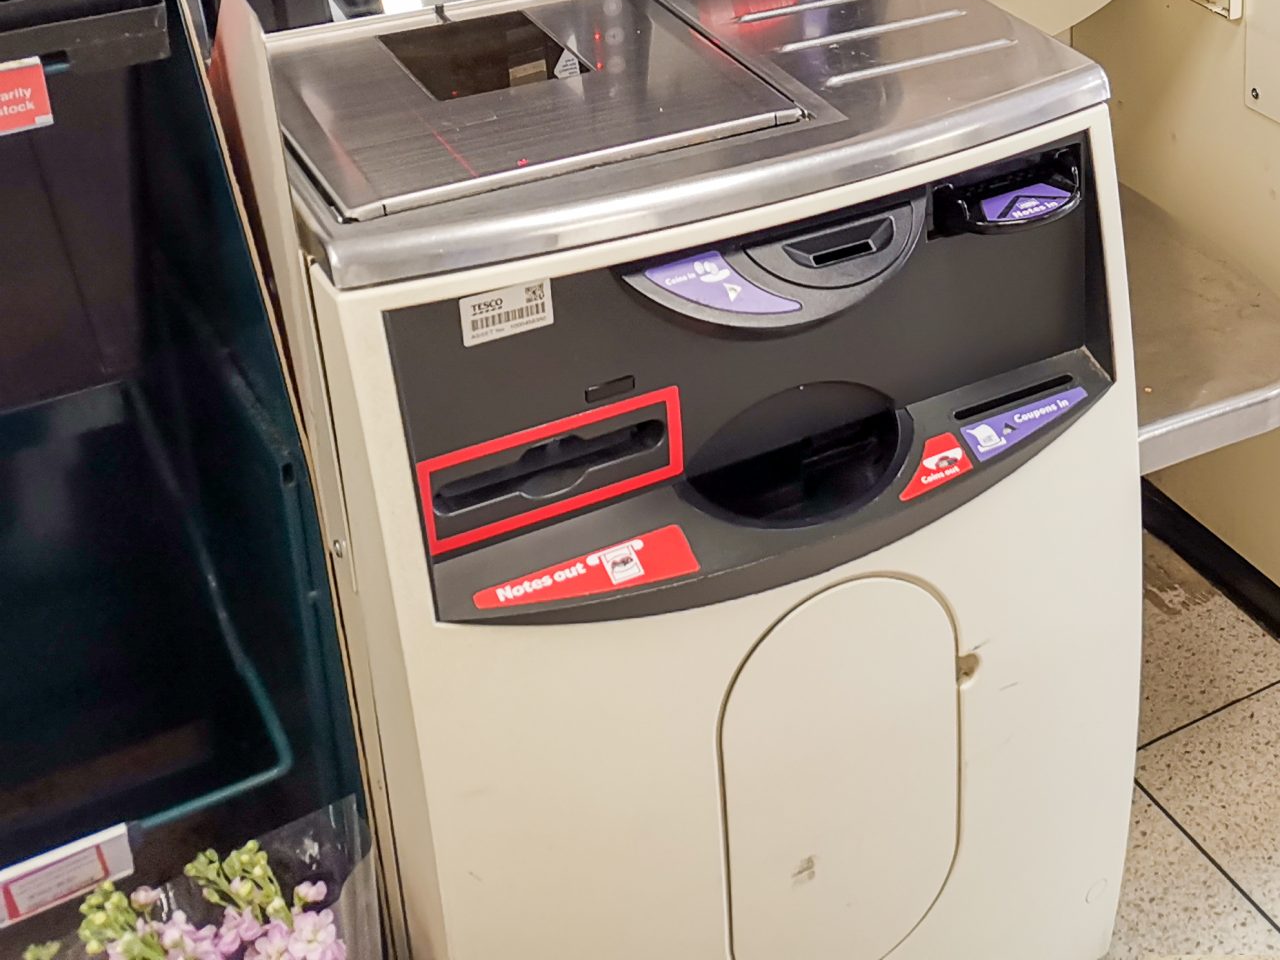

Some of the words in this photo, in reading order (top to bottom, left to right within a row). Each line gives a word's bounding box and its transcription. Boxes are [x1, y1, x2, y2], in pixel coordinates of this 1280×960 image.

[1012, 203, 1046, 218] Notes
[665, 274, 687, 286] Coins
[688, 271, 696, 279] in
[471, 297, 503, 313] TESCO
[1014, 403, 1058, 423] Coupons
[1058, 398, 1069, 408] in
[920, 471, 944, 485] Coins
[944, 466, 961, 477] out
[496, 575, 553, 602] Notes
[553, 562, 587, 582] out
